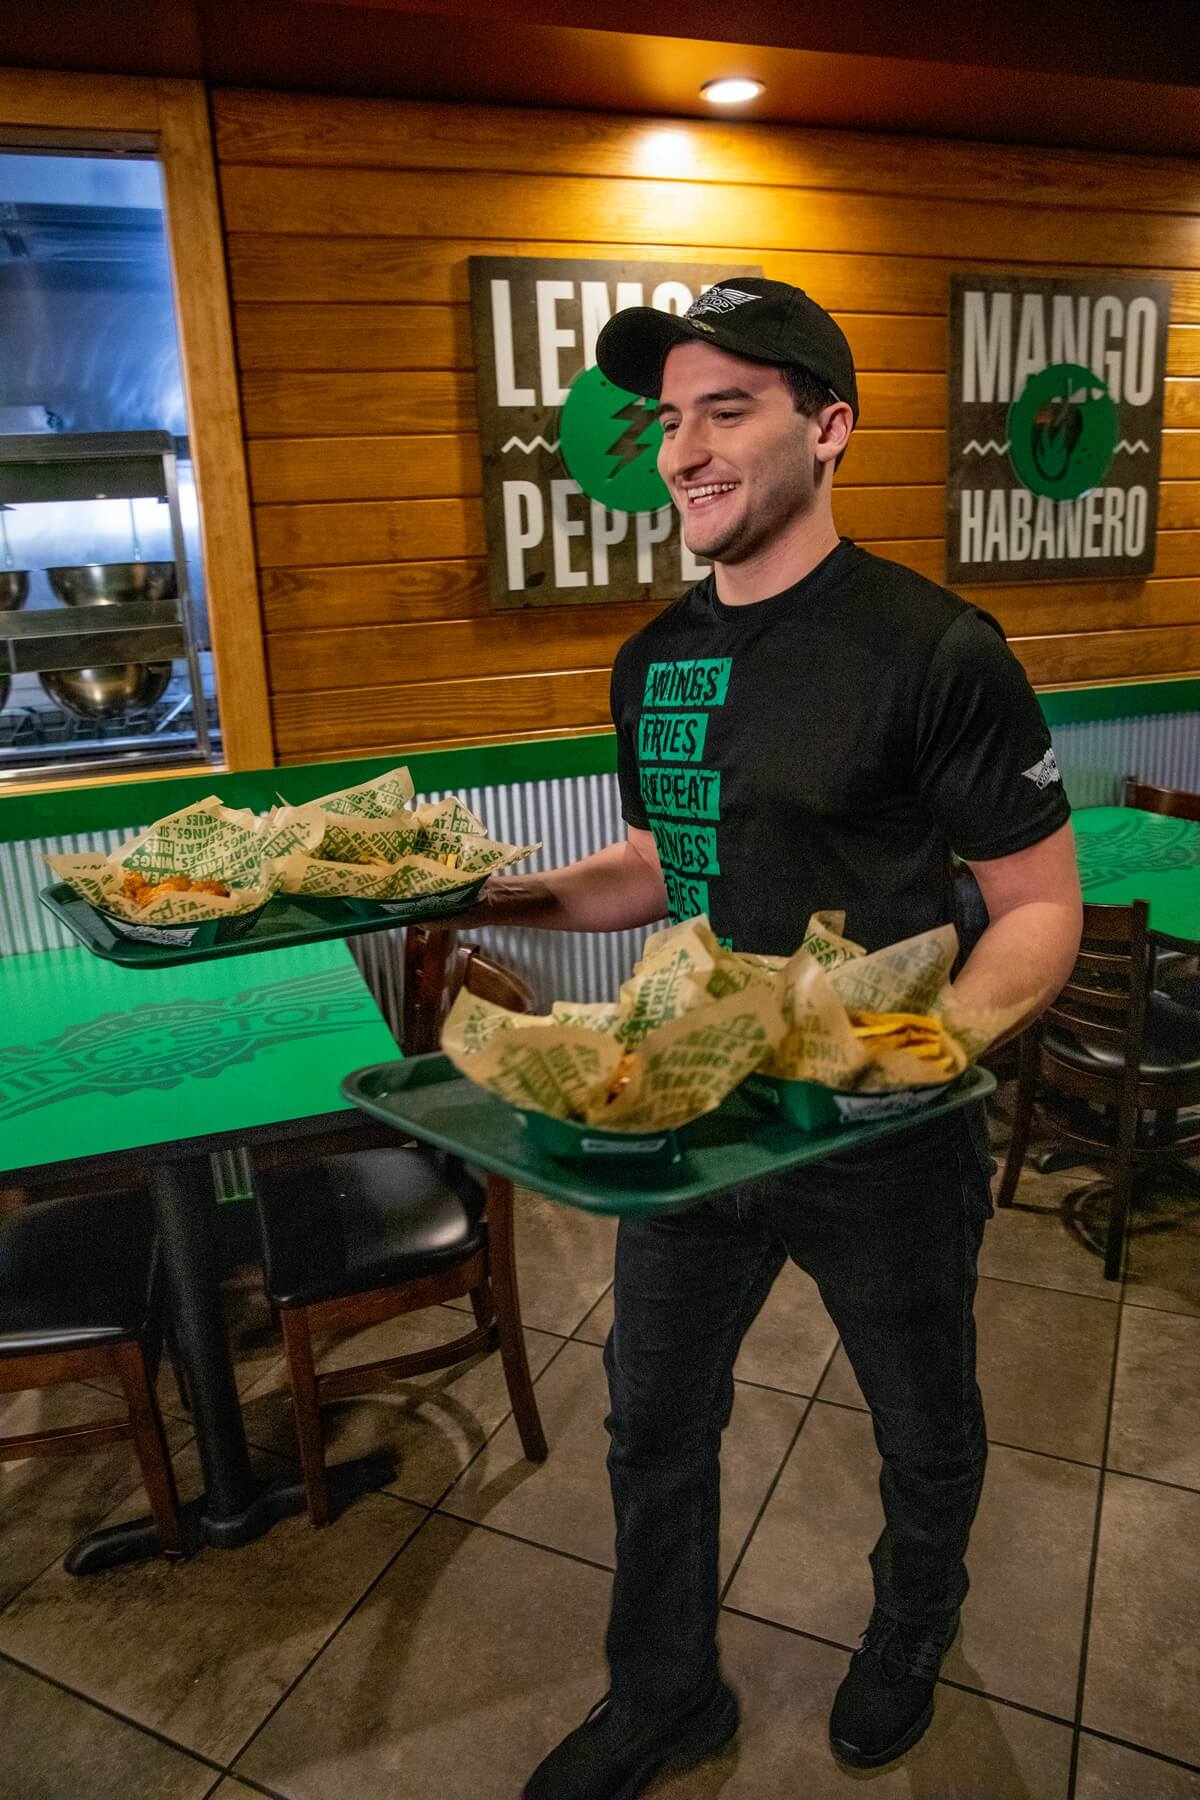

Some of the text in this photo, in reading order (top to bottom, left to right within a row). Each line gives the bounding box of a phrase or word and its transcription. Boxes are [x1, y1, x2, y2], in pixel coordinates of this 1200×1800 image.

[963, 291, 1158, 406] MANGO
[960, 486, 1148, 563] HABANERO
[642, 718, 698, 754] FRIES
[641, 775, 714, 813] REPEAT
